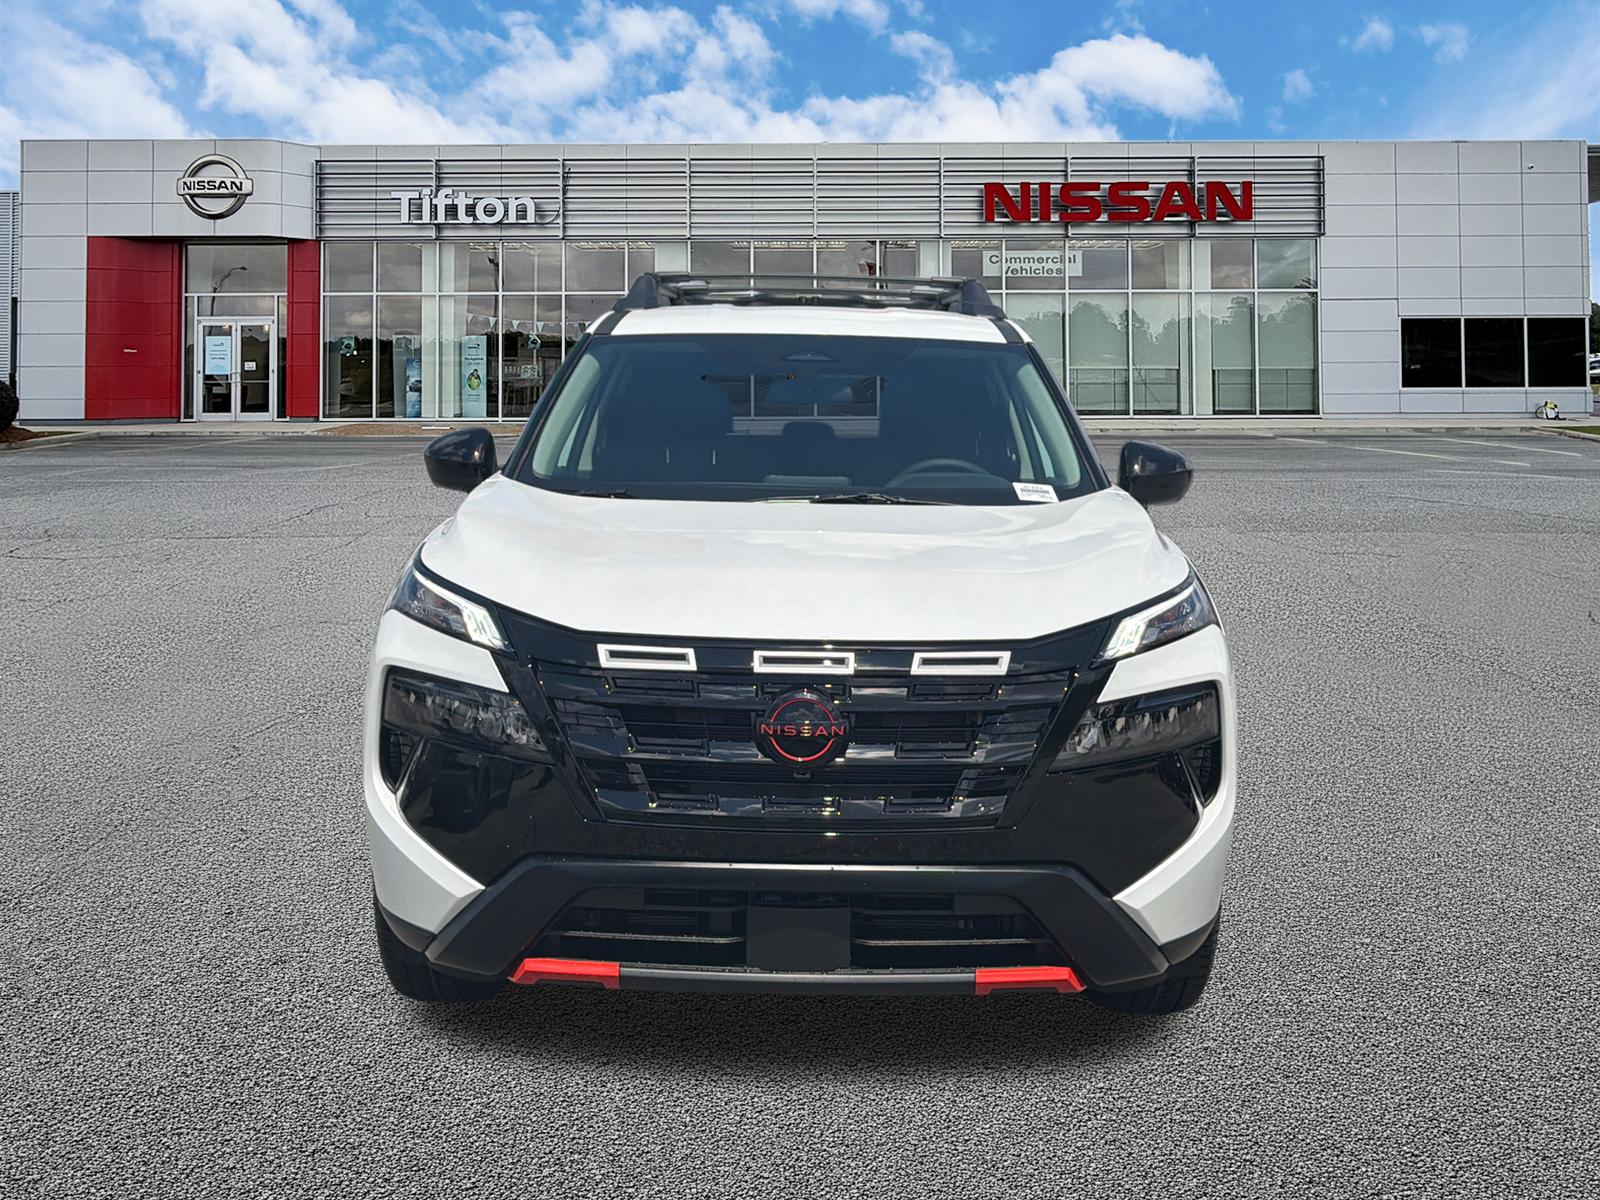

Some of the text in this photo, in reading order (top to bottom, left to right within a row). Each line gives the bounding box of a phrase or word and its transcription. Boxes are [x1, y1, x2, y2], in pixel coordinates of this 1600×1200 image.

[183, 180, 243, 192] NISSAN
[391, 187, 536, 224] Tifton
[984, 182, 1253, 222] NISSAN
[760, 723, 845, 737] NISSAN
